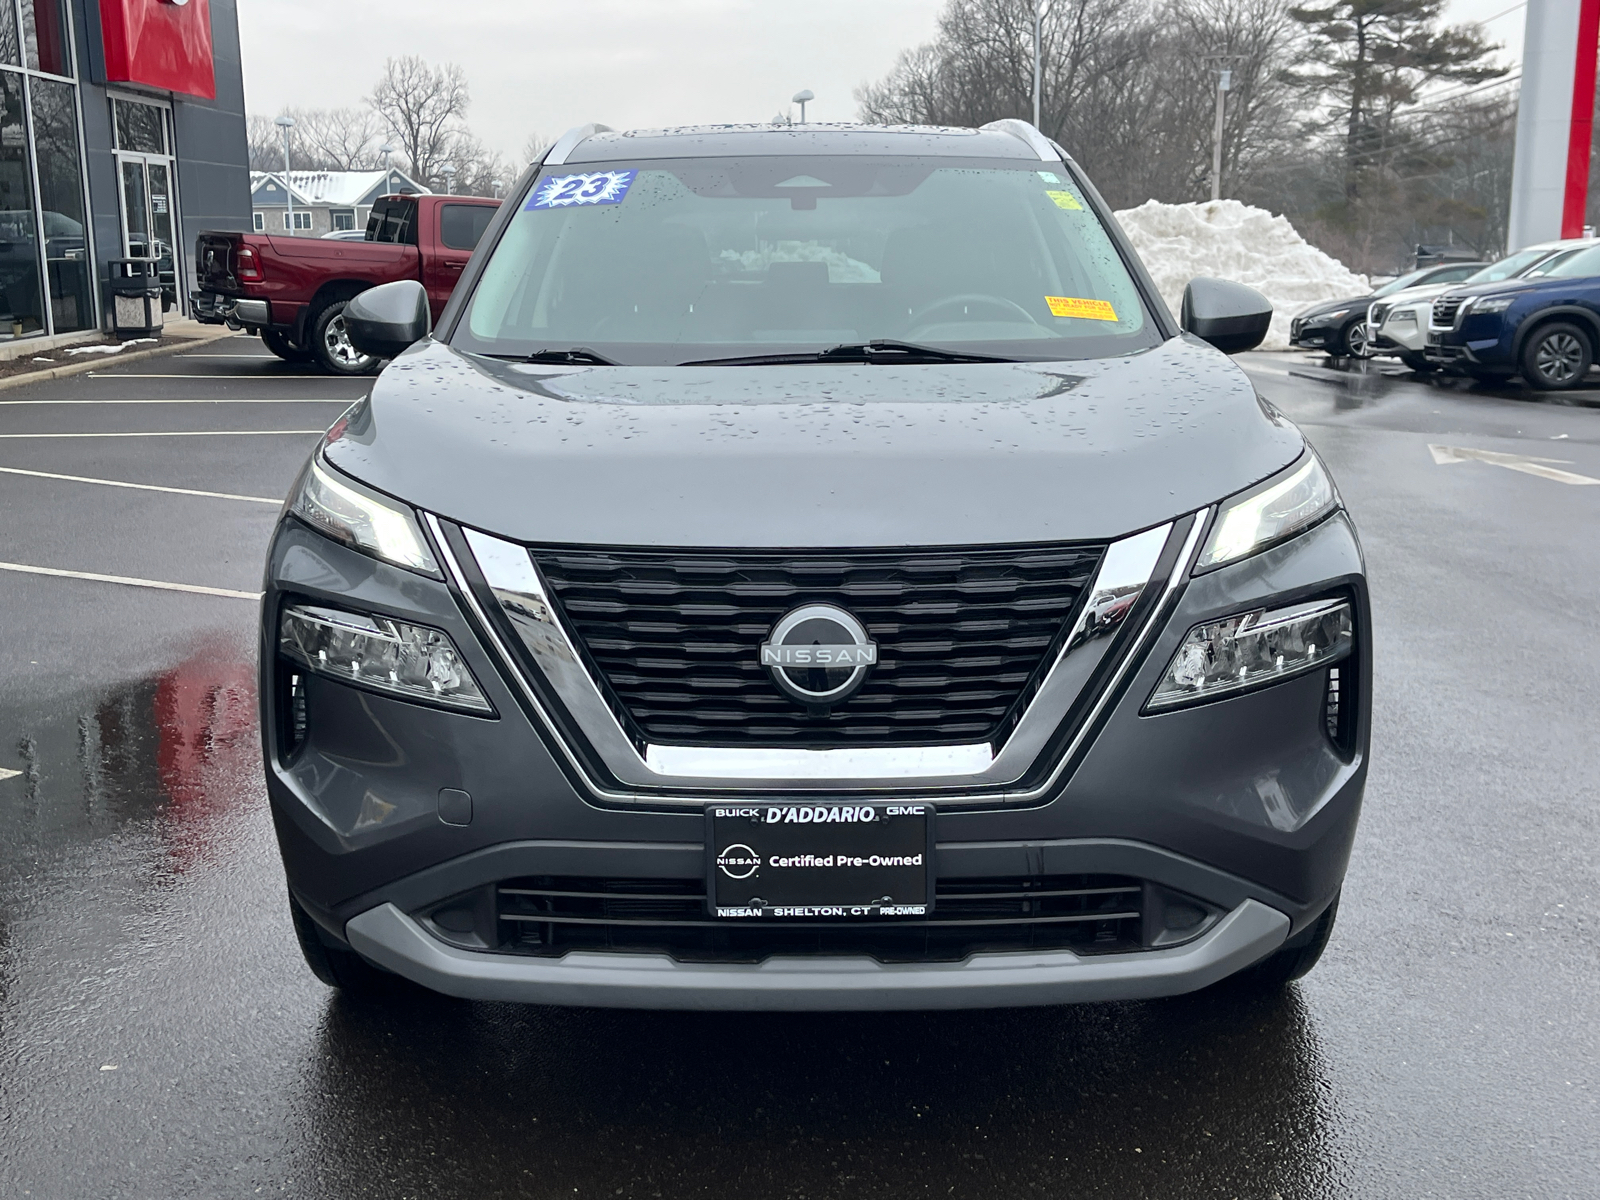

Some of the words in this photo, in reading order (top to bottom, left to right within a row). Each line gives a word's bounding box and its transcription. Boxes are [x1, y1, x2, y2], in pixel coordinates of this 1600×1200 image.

[552, 176, 610, 200] 23
[1071, 299, 1109, 307] VEHICLE
[764, 648, 873, 663] NISSAN
[715, 808, 760, 817] BUICK
[766, 806, 875, 823] D'ADDARIO
[886, 806, 925, 815] GMC
[717, 857, 761, 865] NISSAN
[769, 855, 834, 867] Certified
[837, 854, 922, 867] Pre-Owned
[717, 908, 763, 917] NISSAN
[774, 907, 847, 917] SHELTON,
[851, 907, 871, 916] CT
[880, 906, 926, 916] PRE-OWNED
